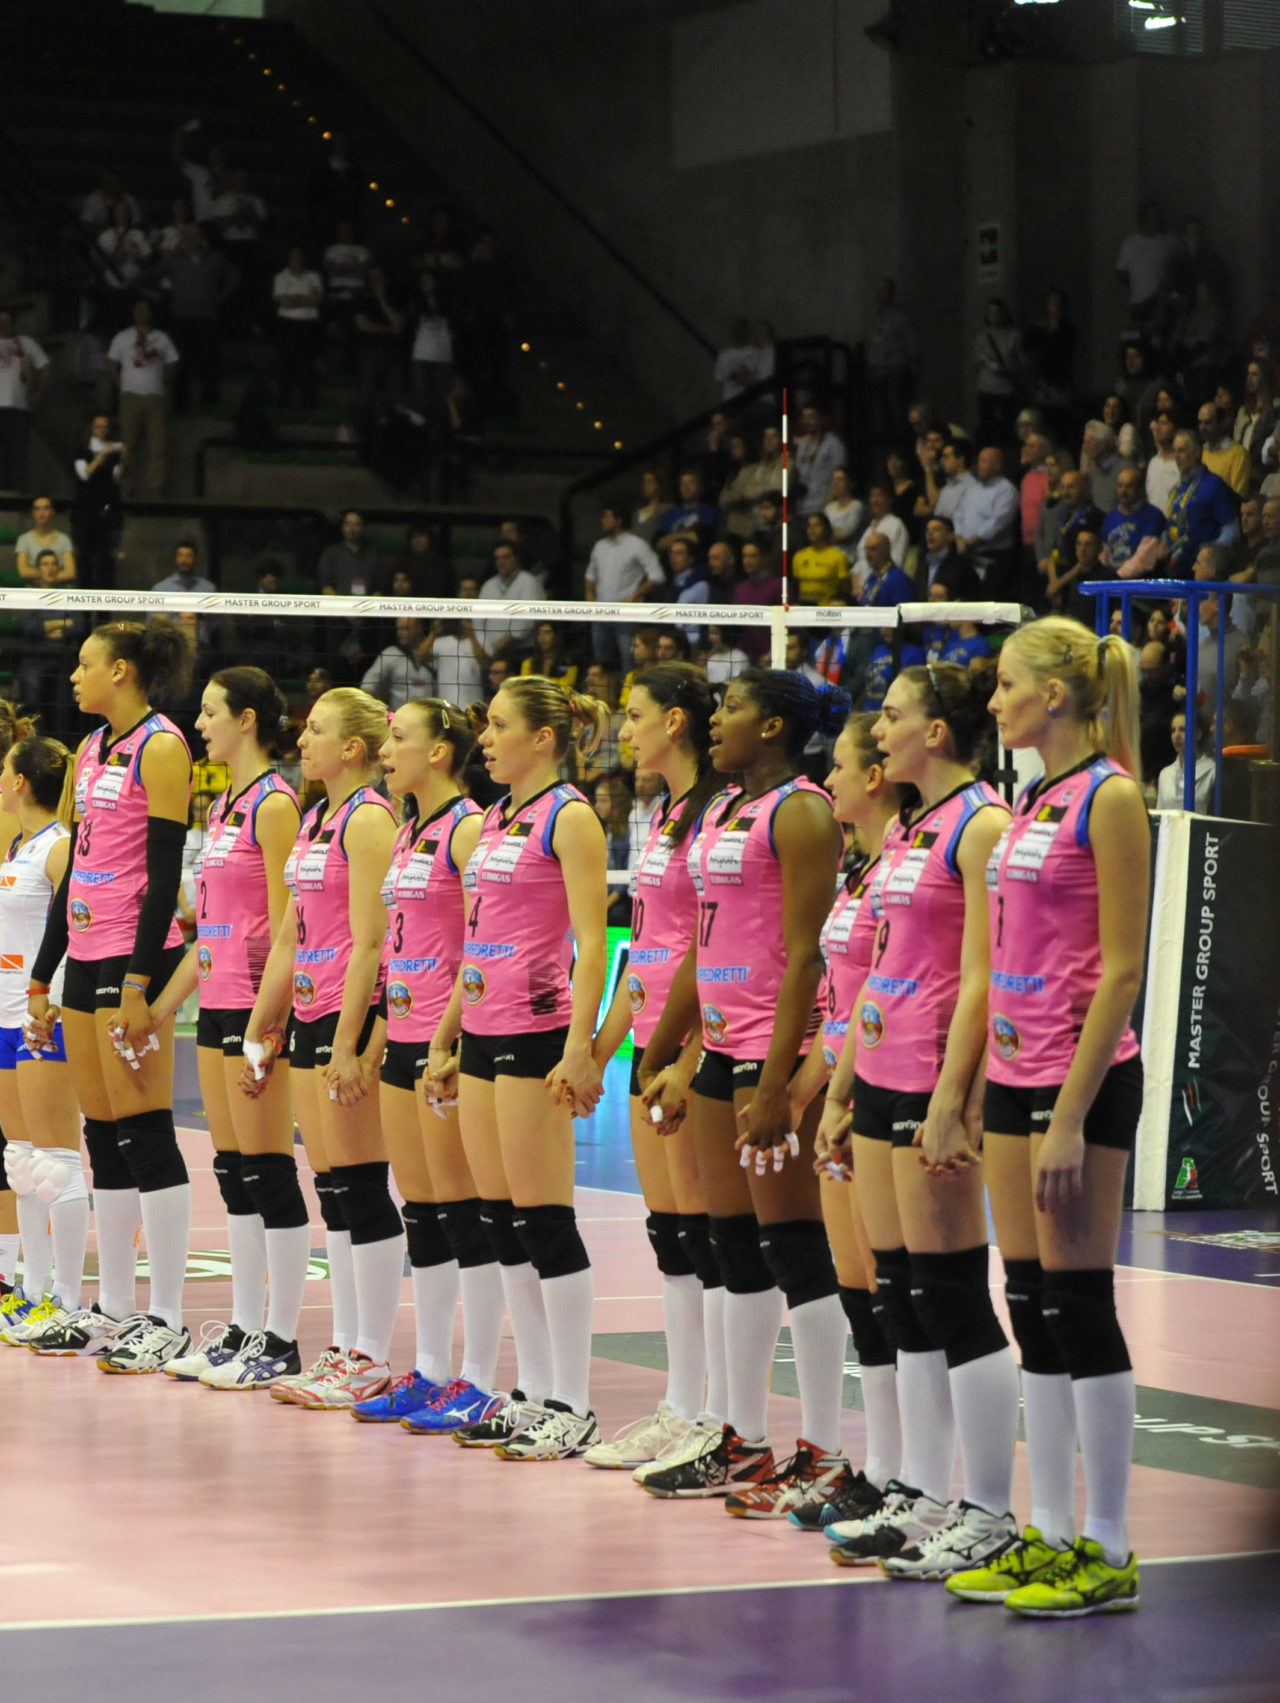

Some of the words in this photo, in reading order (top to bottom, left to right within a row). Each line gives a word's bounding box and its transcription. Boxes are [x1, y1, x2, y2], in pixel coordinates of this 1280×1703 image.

[67, 594, 103, 604] MASTER
[105, 595, 136, 605] GROUP
[137, 596, 165, 606] SPORT
[224, 598, 259, 607] MASTER
[261, 599, 292, 608] GROUP
[294, 600, 321, 609] SPORT
[1203, 832, 1219, 901] SPORT
[393, 911, 405, 953] 3
[468, 896, 482, 938] 4
[700, 901, 719, 947] 17
[875, 918, 890, 970] 9
[1196, 906, 1215, 981] GROUP
[1188, 986, 1207, 1069] MASTER
